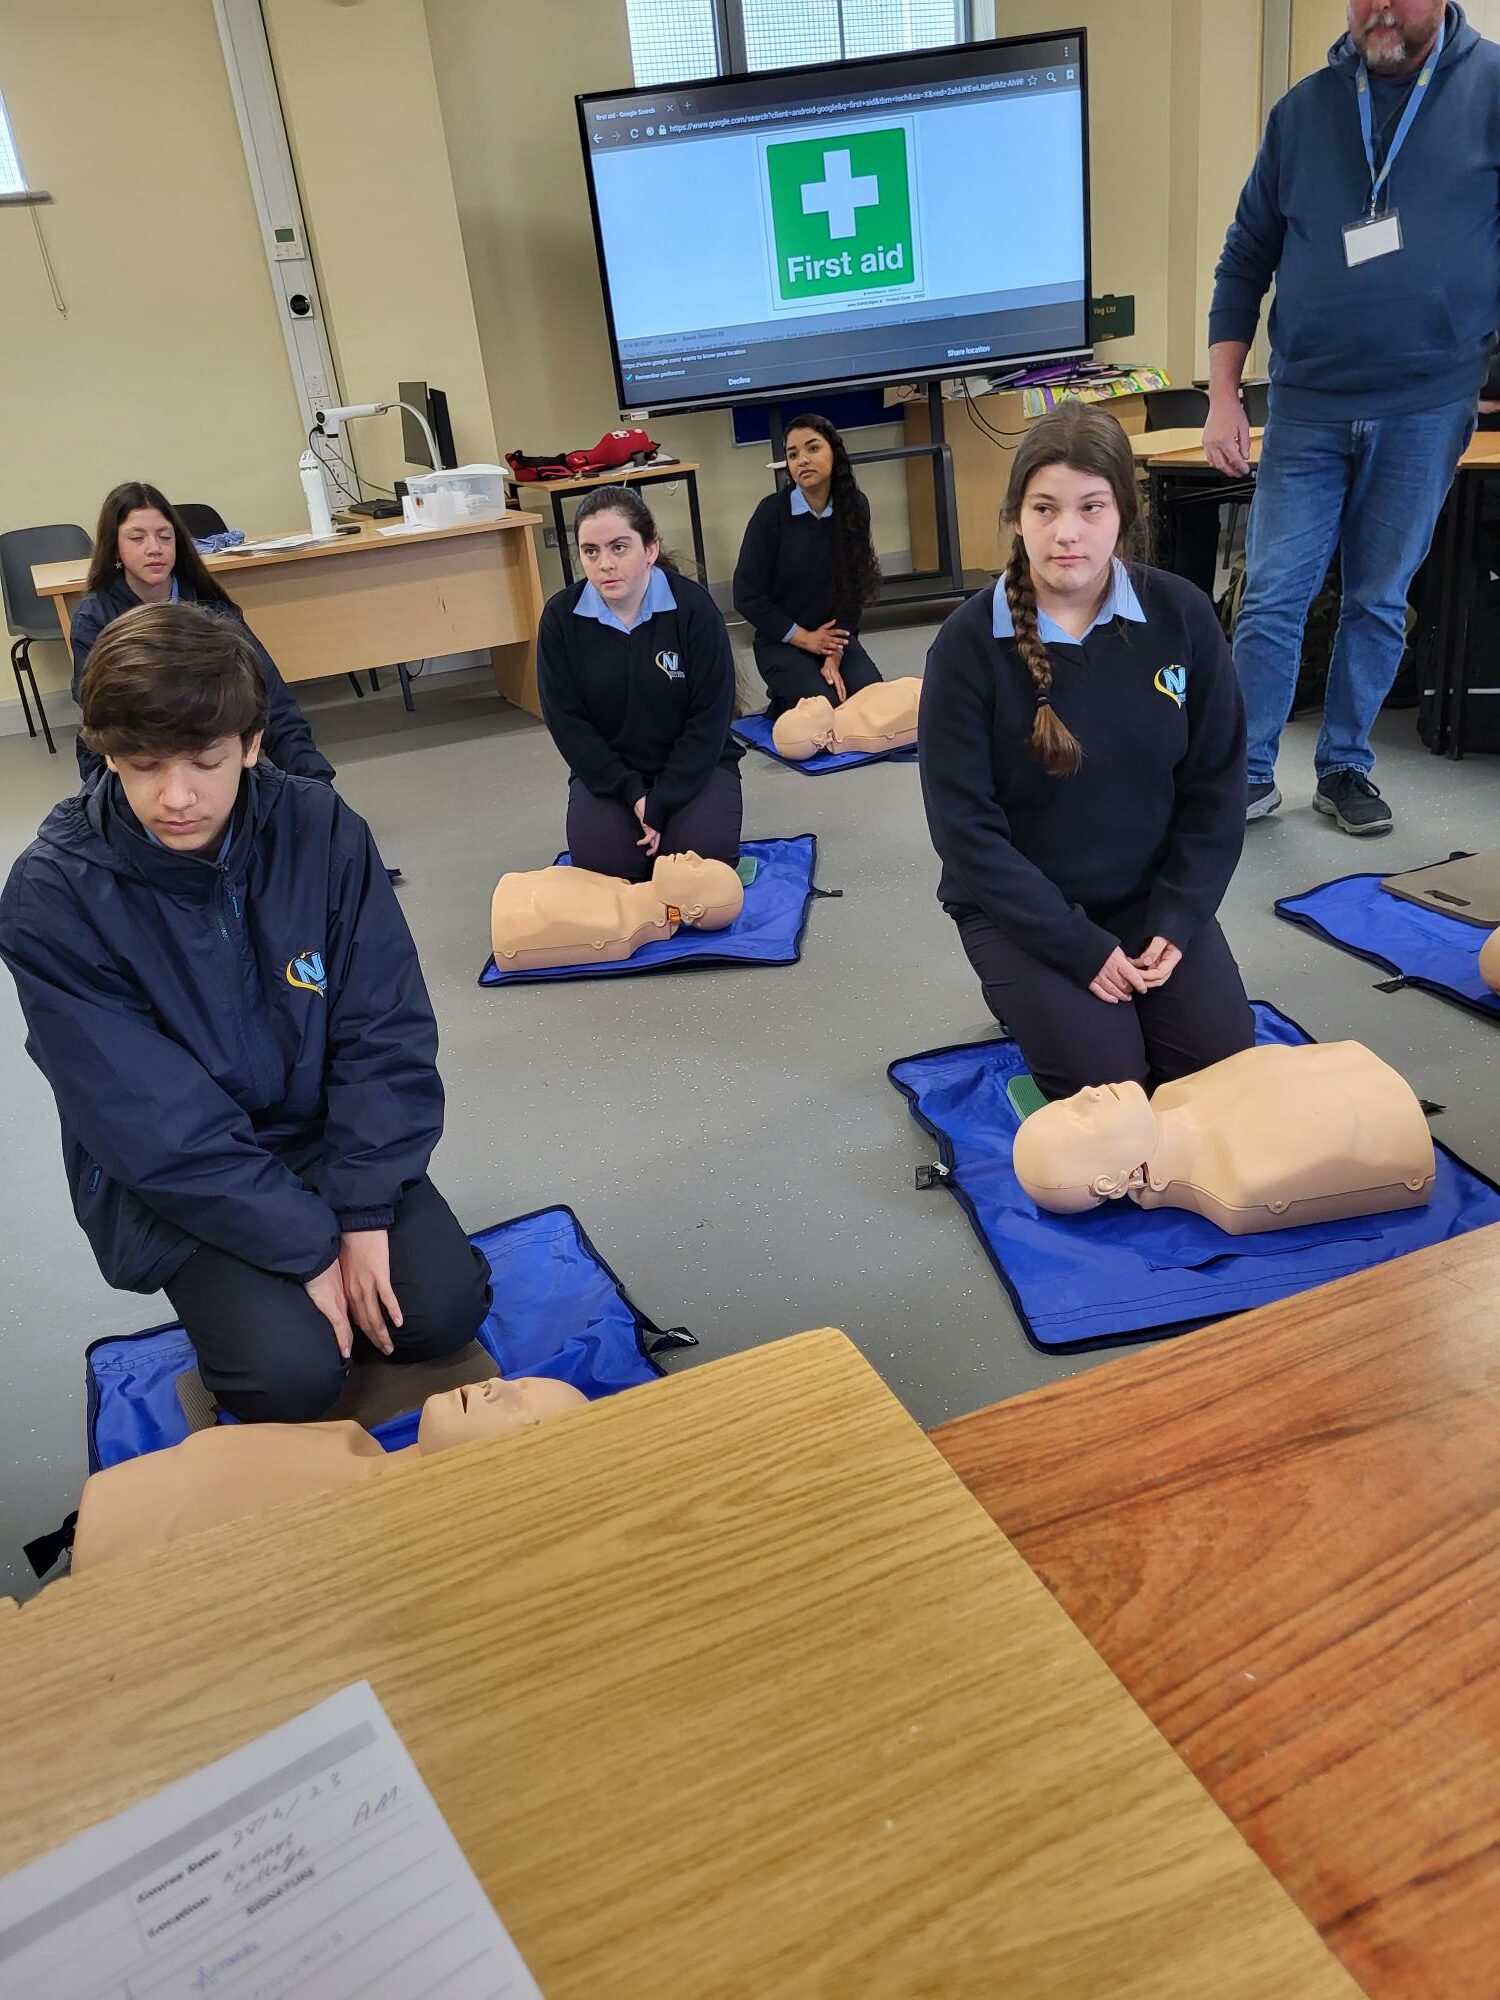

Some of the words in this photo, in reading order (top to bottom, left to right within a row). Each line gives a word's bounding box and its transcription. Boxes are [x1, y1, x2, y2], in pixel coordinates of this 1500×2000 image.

[787, 251, 853, 283] First
[860, 243, 904, 274] aid
[947, 348, 965, 357] Share
[965, 345, 990, 355] location
[728, 376, 751, 386] Decline
